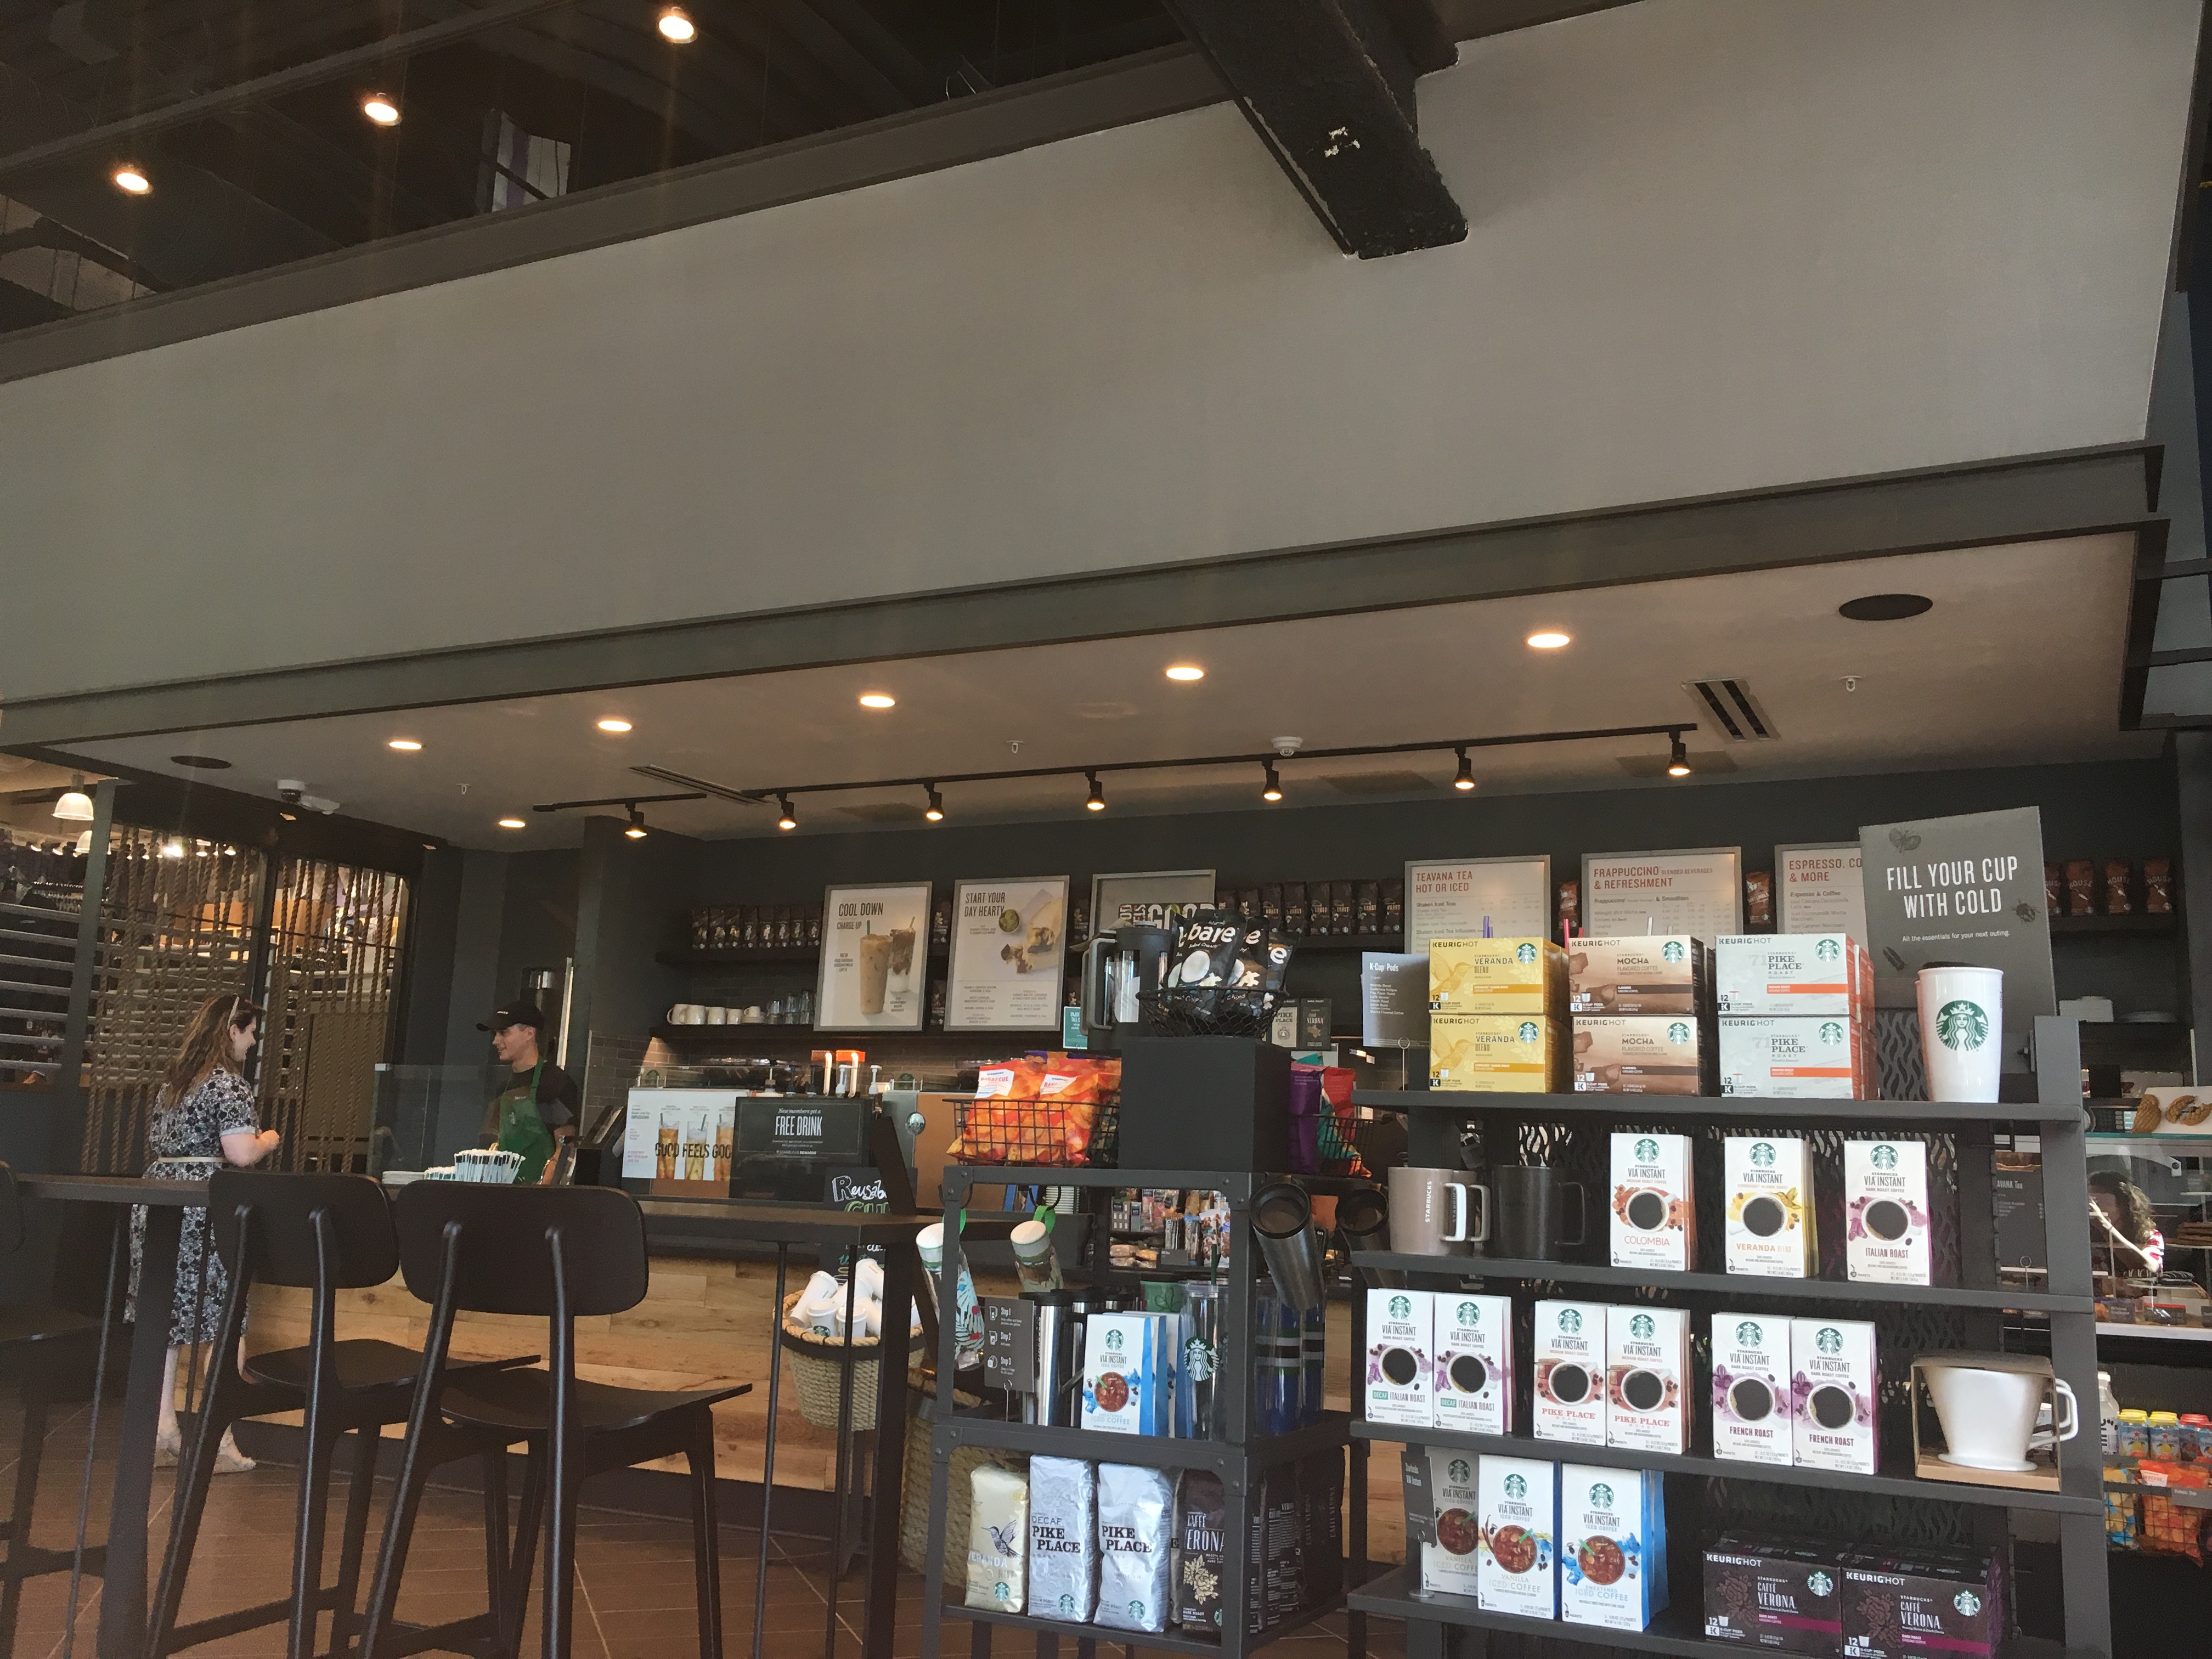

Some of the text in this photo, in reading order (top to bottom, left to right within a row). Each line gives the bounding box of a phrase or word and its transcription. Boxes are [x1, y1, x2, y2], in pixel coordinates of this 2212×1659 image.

[1416, 871, 1472, 882] TEAVANA TEA
[1594, 866, 1659, 877] FRAPPUCCINO
[1790, 872, 1830, 882] & MORE
[1887, 856, 2017, 891] FILL YOUR CUP
[1416, 883, 1469, 893] HOT OR ICED
[1594, 878, 1673, 889] & REFRESHMENT
[966, 892, 1006, 904] START YOUR
[1904, 888, 2001, 918] WITH COLD
[839, 902, 883, 916] COOL DOWN
[964, 906, 1005, 917] DAY HEARTY
[856, 921, 862, 929] UP
[1188, 922, 1235, 943] bare
[1369, 962, 1399, 972] K-Cup Pods
[775, 1116, 822, 1136] FREE DRINK
[655, 1142, 680, 1158] GOOD
[682, 1143, 710, 1158] FEELS
[1628, 1168, 1666, 1178] VIA INSTANT
[1743, 1173, 1782, 1183] VIA INSTANT
[1864, 1176, 1905, 1187] VIA INSTANT
[1624, 1235, 1670, 1246] COLOMBIA
[1736, 1243, 1775, 1252] VERANDA
[1865, 1248, 1909, 1259] ITALIAN ROAST
[1551, 1339, 1588, 1351] VIA INSTANT
[1100, 1355, 1127, 1364] VIA INSTANT
[1730, 1353, 1770, 1365] VIA INSTANT
[1390, 1392, 1408, 1402] ITALIAN
[1409, 1394, 1425, 1403] ROAST
[1542, 1408, 1595, 1419] PIKE PLACE
[1615, 1415, 1670, 1427] PIKE PLACE
[1730, 1426, 1773, 1438] FRENCH ROAST
[1809, 1434, 1854, 1447] FRENCH ROAST
[1498, 1504, 1533, 1517] VIA INSTANT
[1032, 1515, 1062, 1525] DECAF
[1032, 1526, 1065, 1539] PIKE
[1102, 1525, 1135, 1539] PIKE
[1037, 1539, 1081, 1553] PLACE
[1106, 1539, 1152, 1553] PLACE
[1445, 1555, 1472, 1564] VANILLA
[1706, 1554, 1762, 1567] KEURIG HOT
[1501, 1573, 1529, 1583] VANILLA
[1847, 1572, 1905, 1585] KEURIG HOT
[1489, 1579, 1541, 1593] ICED COFFEE
[1575, 1588, 1628, 1601] ICED COFFEE
[1758, 1592, 1797, 1610] VERONA
[1709, 1617, 1718, 1626] 12
[1900, 1611, 1942, 1629] VERONA
